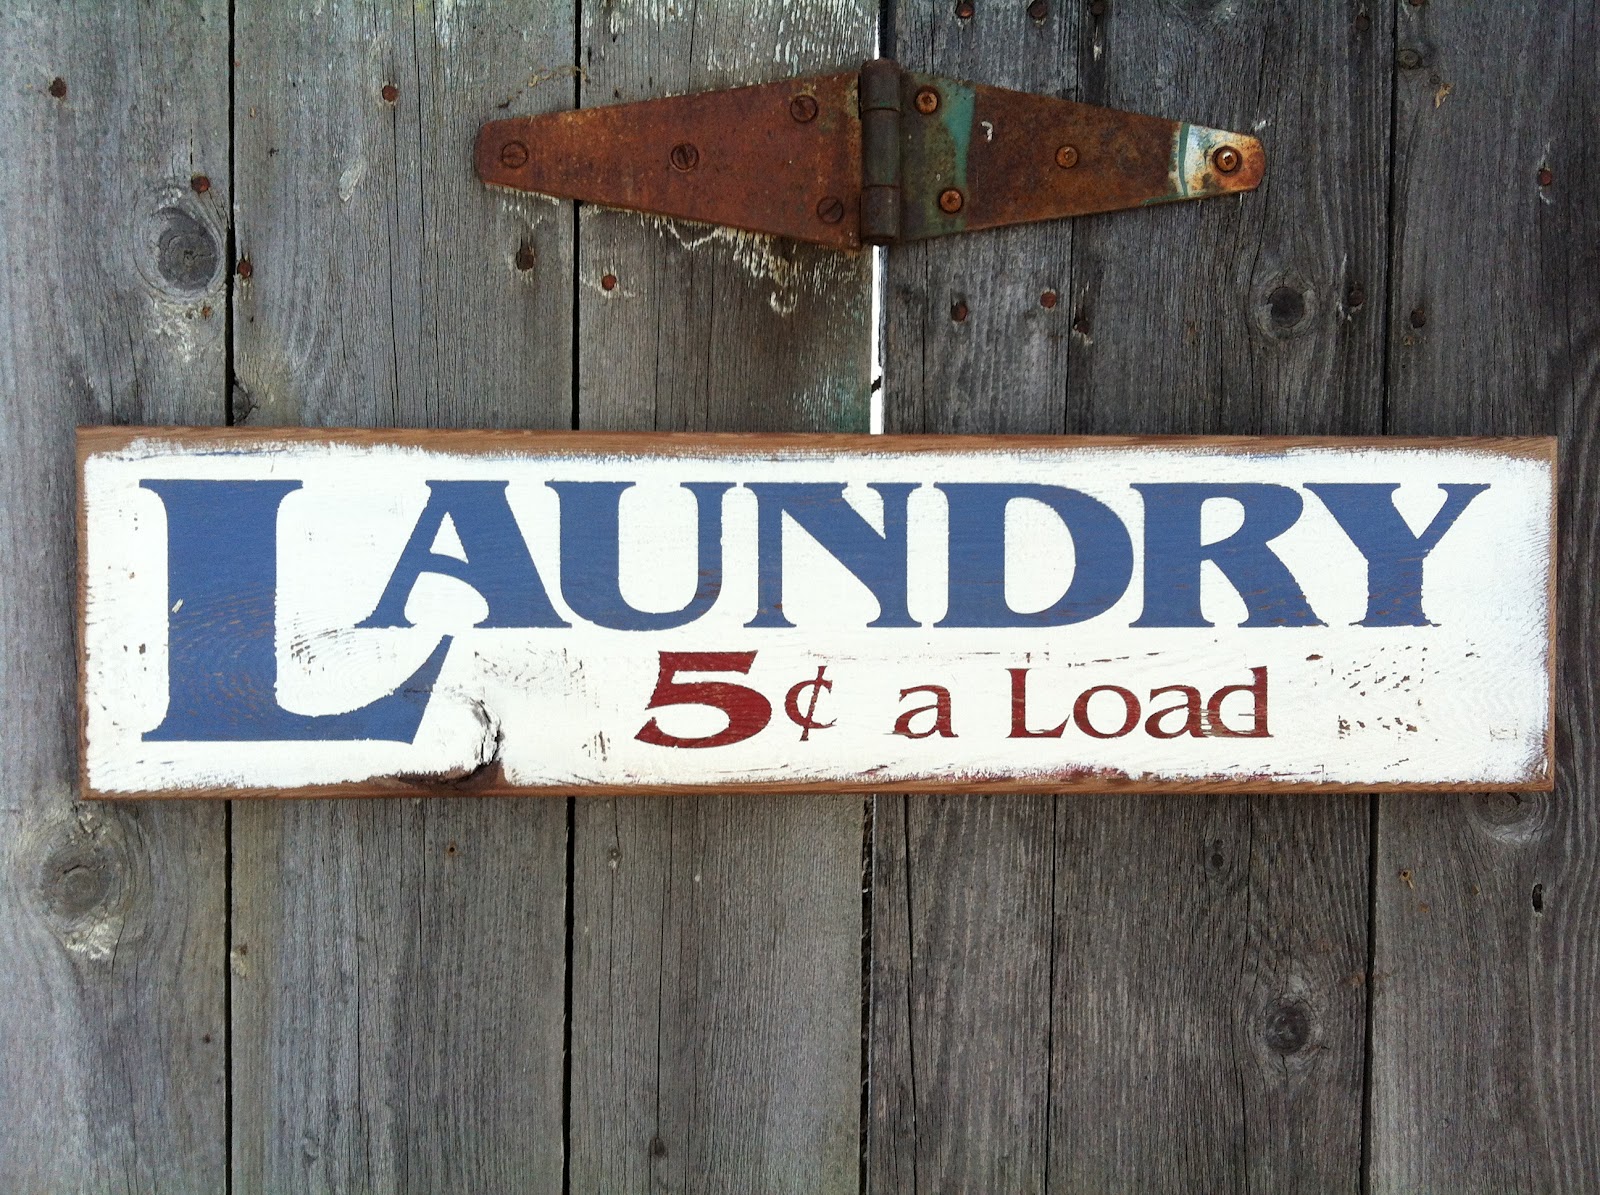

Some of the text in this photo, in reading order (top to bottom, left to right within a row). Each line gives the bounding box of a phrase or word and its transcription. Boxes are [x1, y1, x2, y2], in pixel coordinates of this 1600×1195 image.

[141, 479, 1490, 744] LAUNDRY
[634, 651, 1273, 748] 5¢ a Load
